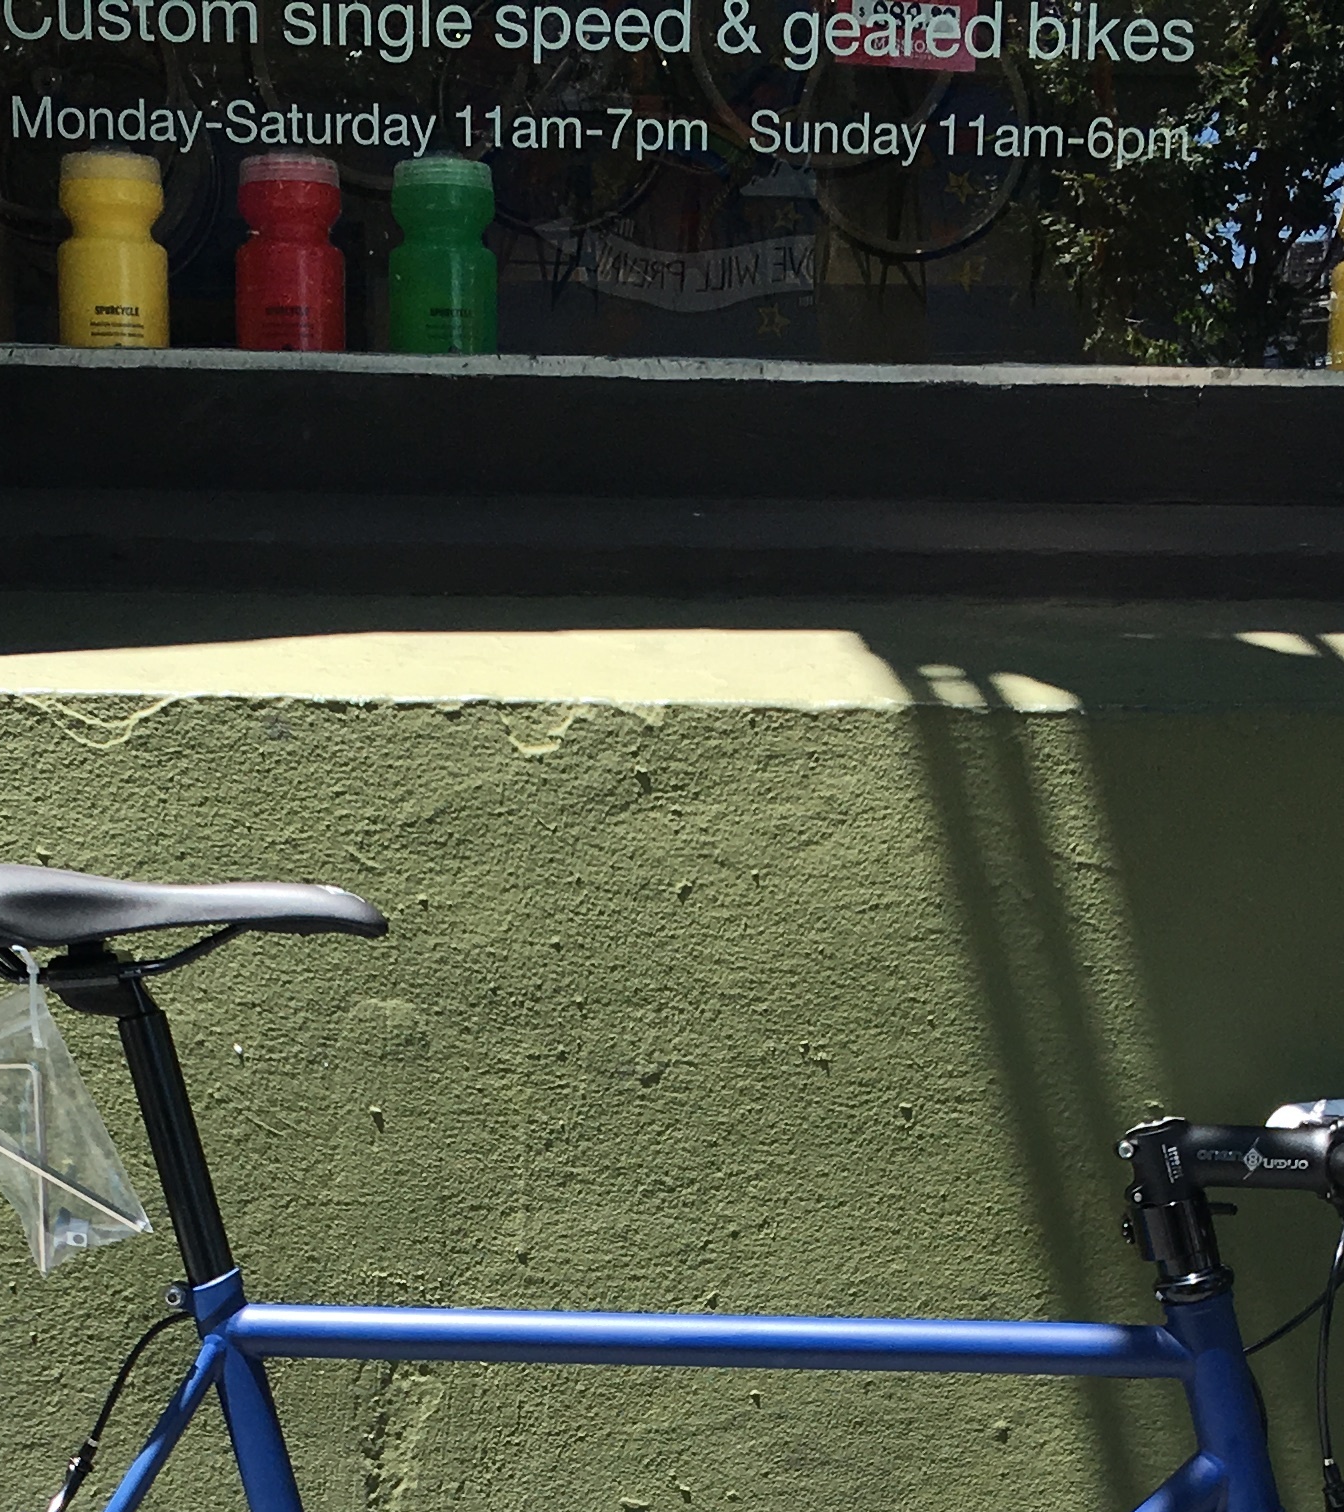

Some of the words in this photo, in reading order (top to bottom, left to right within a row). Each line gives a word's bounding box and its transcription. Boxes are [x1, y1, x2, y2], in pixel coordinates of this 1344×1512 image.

[3, 0, 259, 44] Custom
[283, 0, 471, 63] single
[495, 0, 692, 64] speed
[717, 0, 761, 54] &
[782, 1, 1004, 70] geared
[1028, 1, 1195, 63] bikes
[12, 95, 436, 157] Monday-Saturday
[455, 105, 707, 160] 11am-7pm
[750, 109, 926, 166] Sunday
[939, 113, 1189, 169] 11am-6pm
